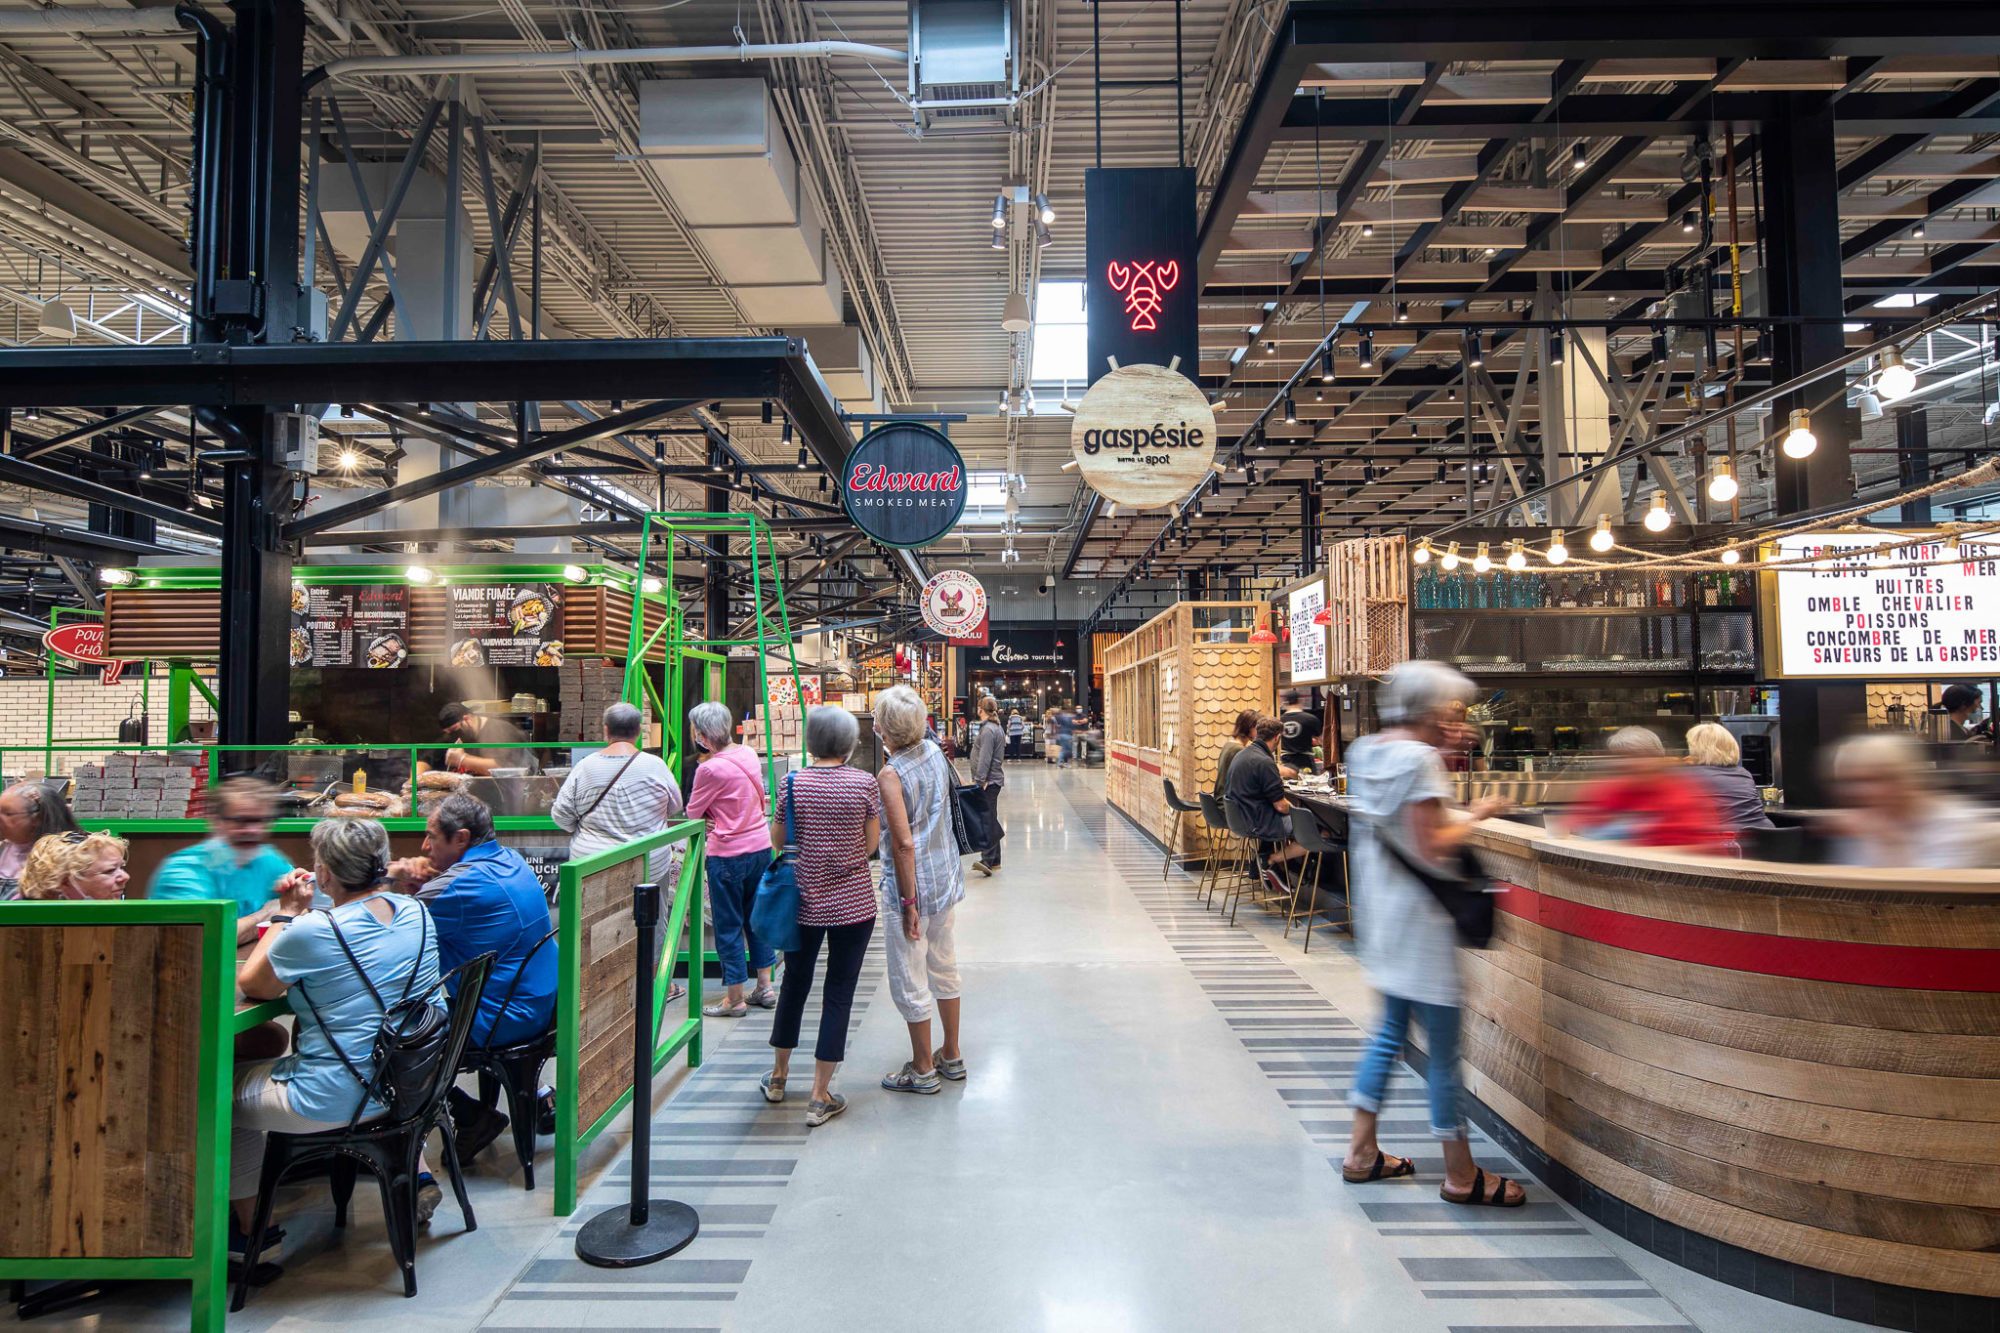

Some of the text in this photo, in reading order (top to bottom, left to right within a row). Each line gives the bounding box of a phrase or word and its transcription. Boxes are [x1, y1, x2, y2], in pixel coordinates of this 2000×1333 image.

[1084, 421, 1204, 455] gaspésie
[1145, 454, 1171, 466] spot
[849, 463, 962, 492] Edward
[855, 498, 955, 507] SMOKED MEAT
[1909, 563, 1928, 577] DE
[1963, 561, 1997, 577] MER
[453, 584, 515, 601] VIANDE FUMÉE
[1875, 578, 1944, 594] HUITRES
[359, 590, 404, 601] Edward
[1807, 596, 1974, 612] OMBLE CHEVALIER
[306, 621, 336, 629] POUTINES
[1846, 613, 1929, 629] POISSONS
[1807, 629, 1997, 646] CONCOMBRE DE MER
[75, 642, 104, 655] CHÔ
[1814, 646, 2000, 663] SAVEURS DE LA GASPES
[525, 856, 544, 864] UNE
